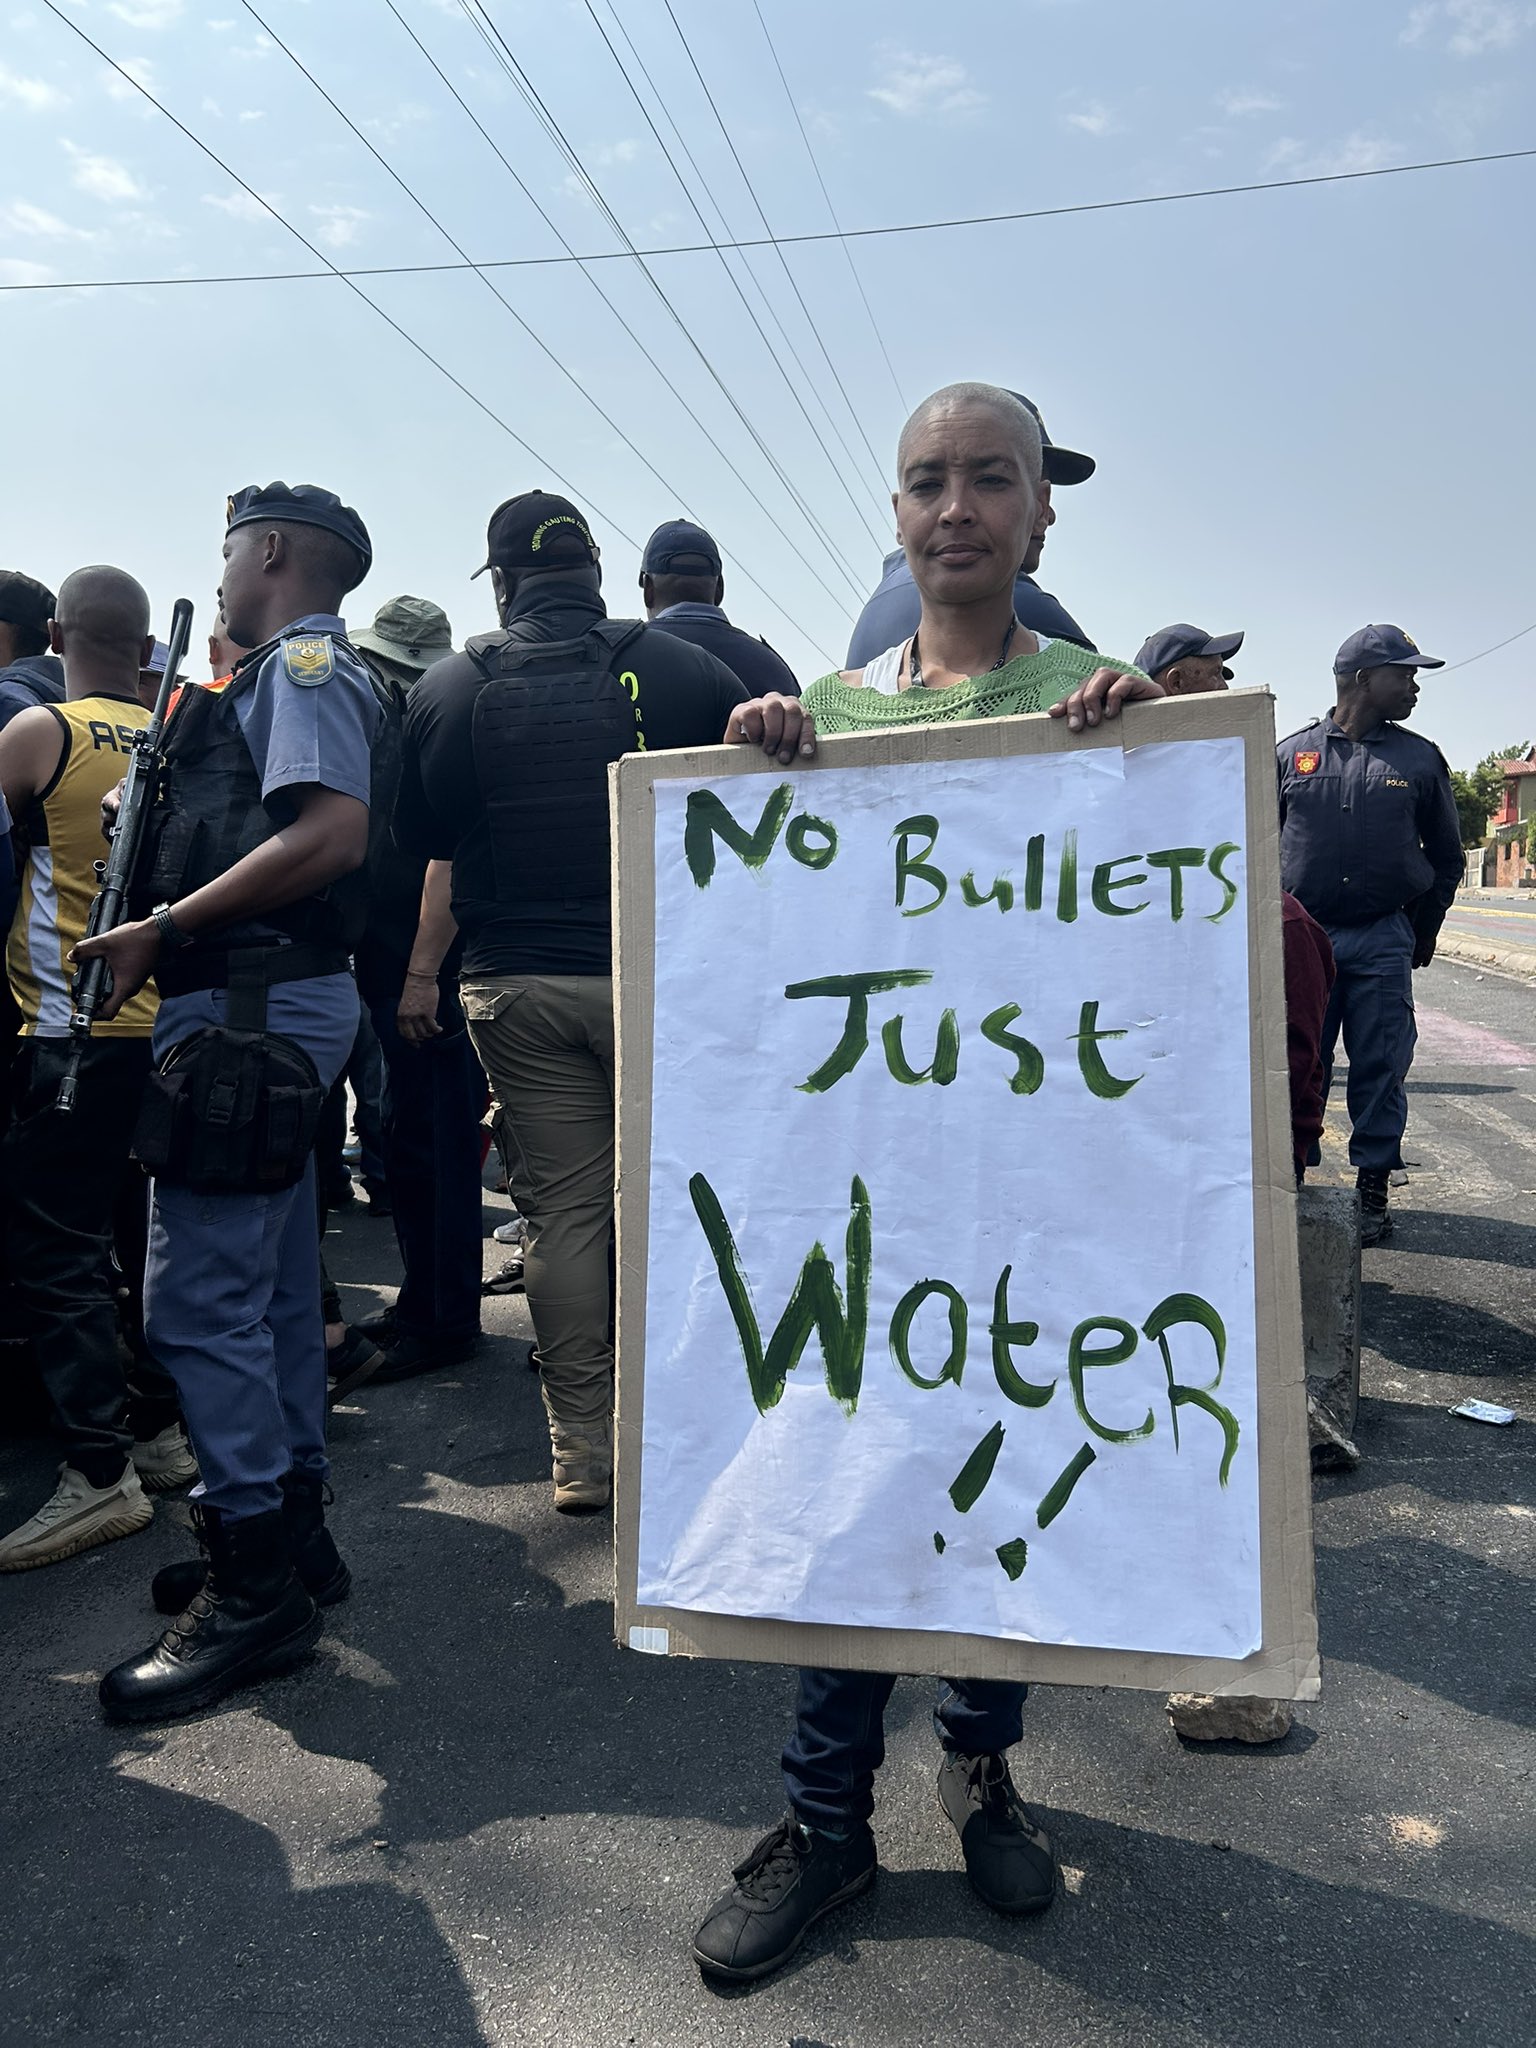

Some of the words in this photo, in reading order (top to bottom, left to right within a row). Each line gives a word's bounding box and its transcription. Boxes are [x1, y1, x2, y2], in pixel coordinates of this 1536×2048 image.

[288, 641, 325, 650] POLICE
[1386, 779, 1408, 787] POLICE
[684, 782, 839, 889] No
